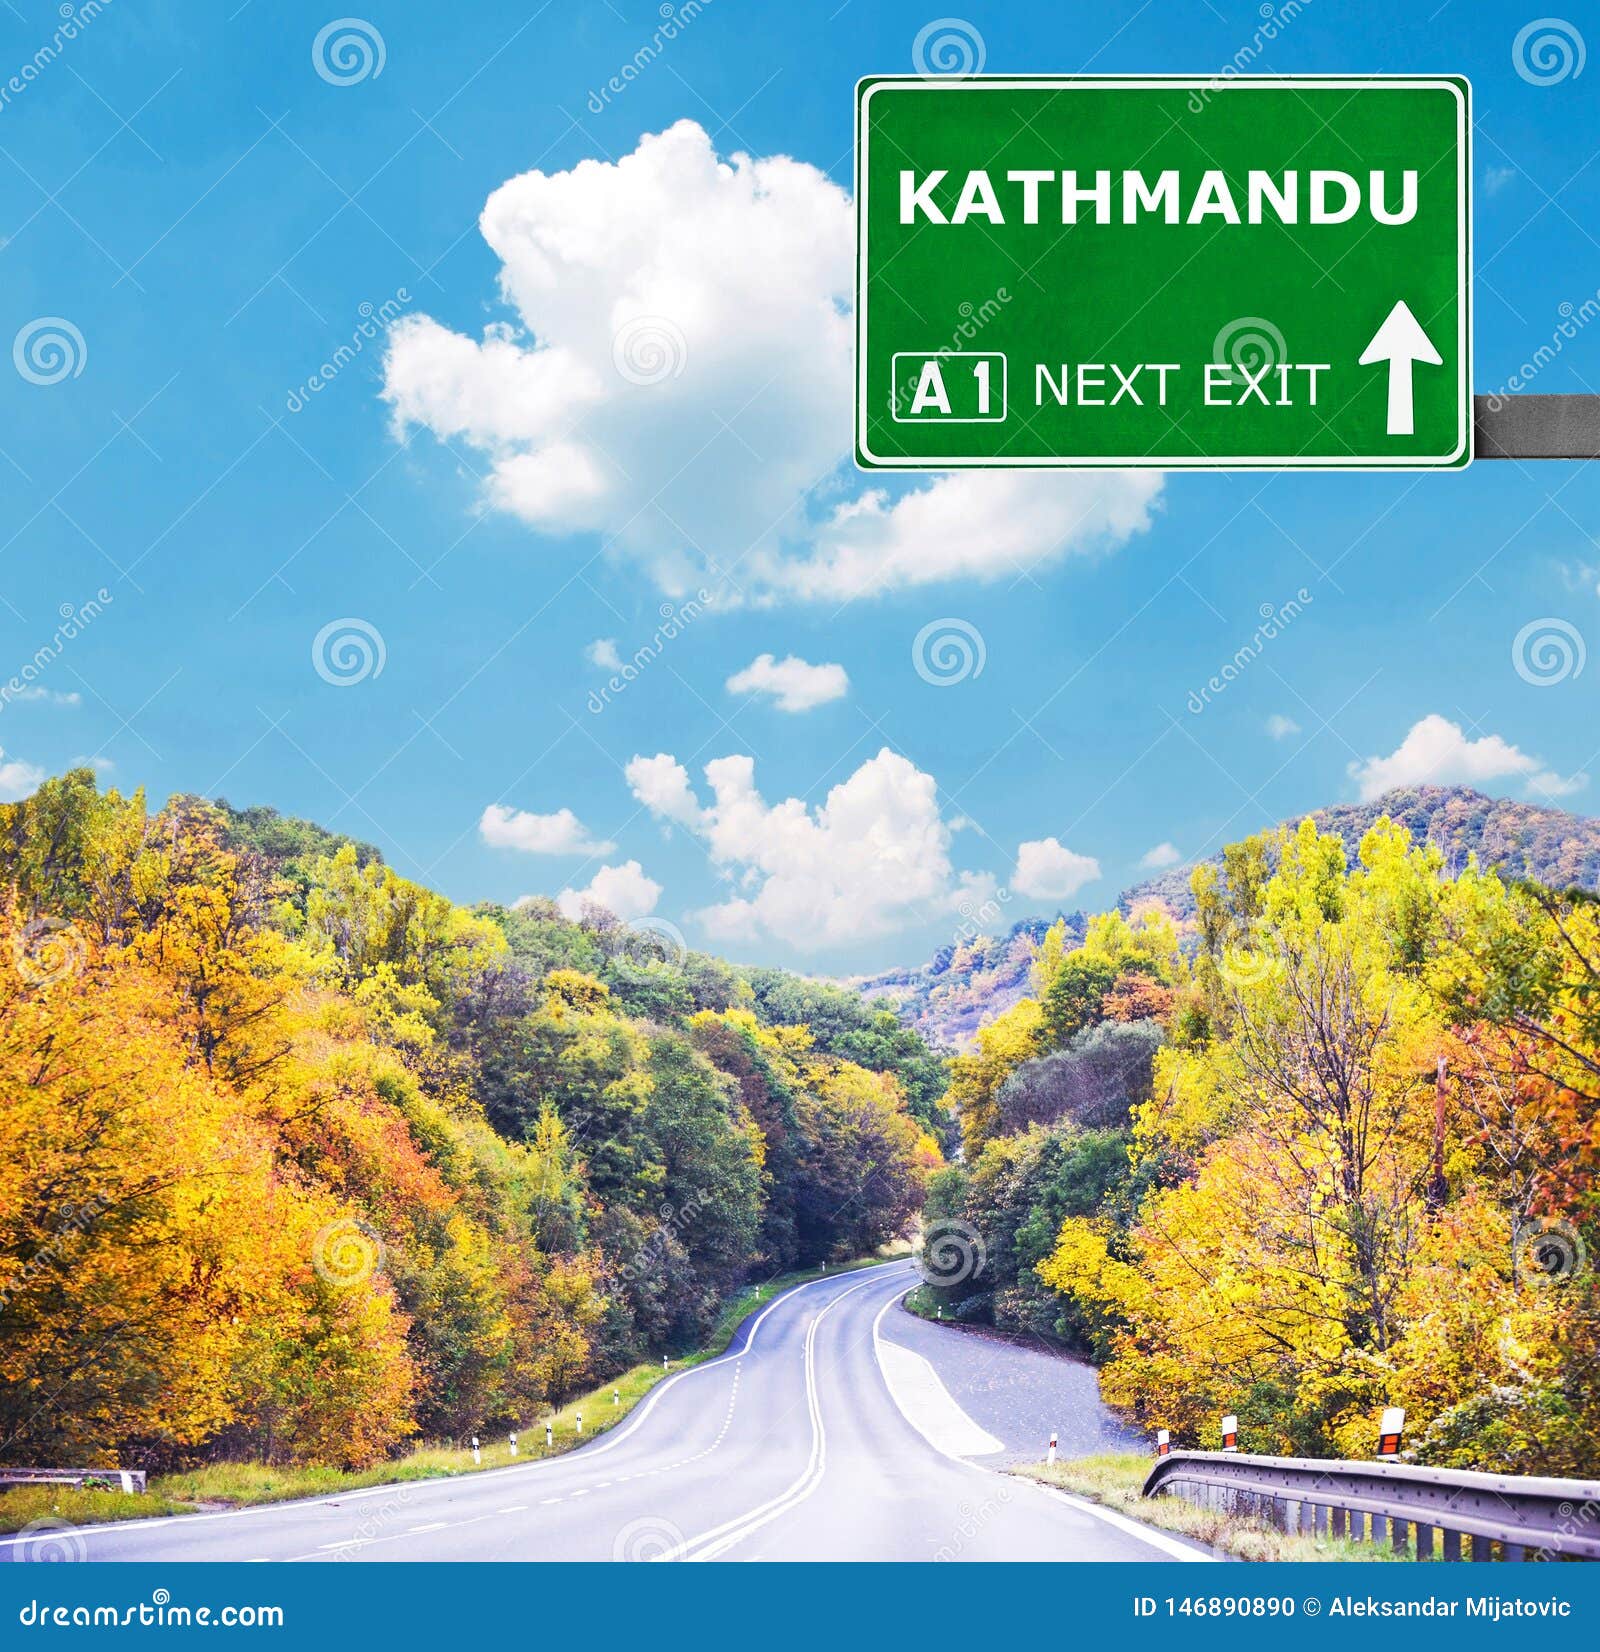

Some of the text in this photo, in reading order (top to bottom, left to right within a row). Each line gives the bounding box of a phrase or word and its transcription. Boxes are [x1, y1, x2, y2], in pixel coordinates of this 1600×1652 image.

[900, 171, 1418, 226] KATHMANDU
[1035, 364, 1180, 406] NEXT
[1204, 364, 1331, 406] EXIT
